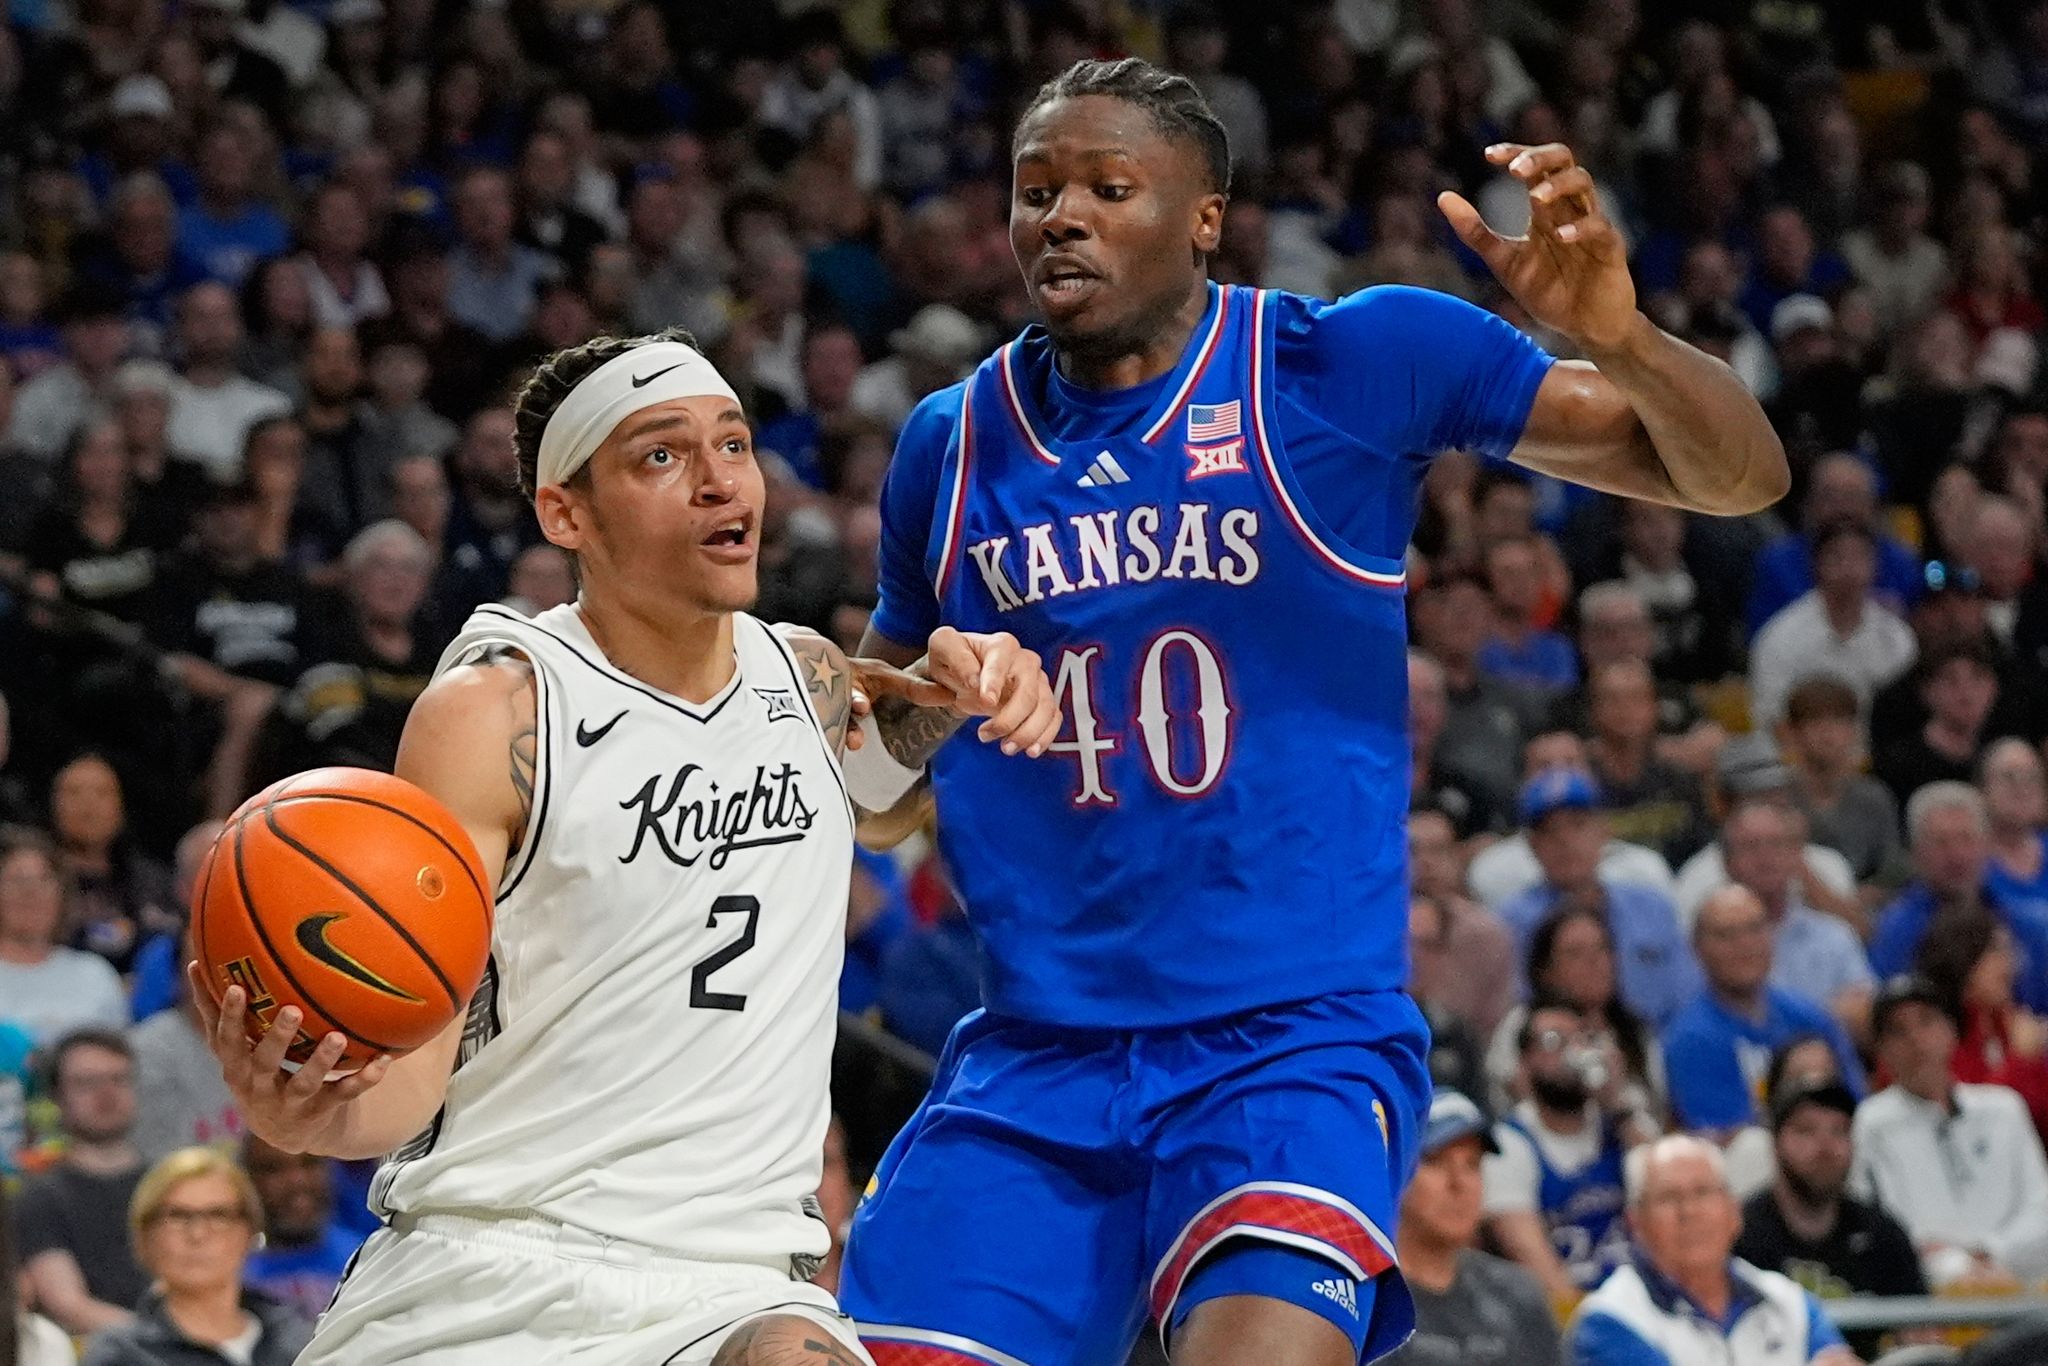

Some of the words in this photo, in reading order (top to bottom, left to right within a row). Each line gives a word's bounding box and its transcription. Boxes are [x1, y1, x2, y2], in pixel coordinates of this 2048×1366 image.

[966, 503, 1261, 613] KANSAS
[1048, 629, 1233, 805] 40
[618, 762, 819, 871] Knights
[689, 894, 761, 1012] 2
[1311, 1281, 1360, 1322] adidas
